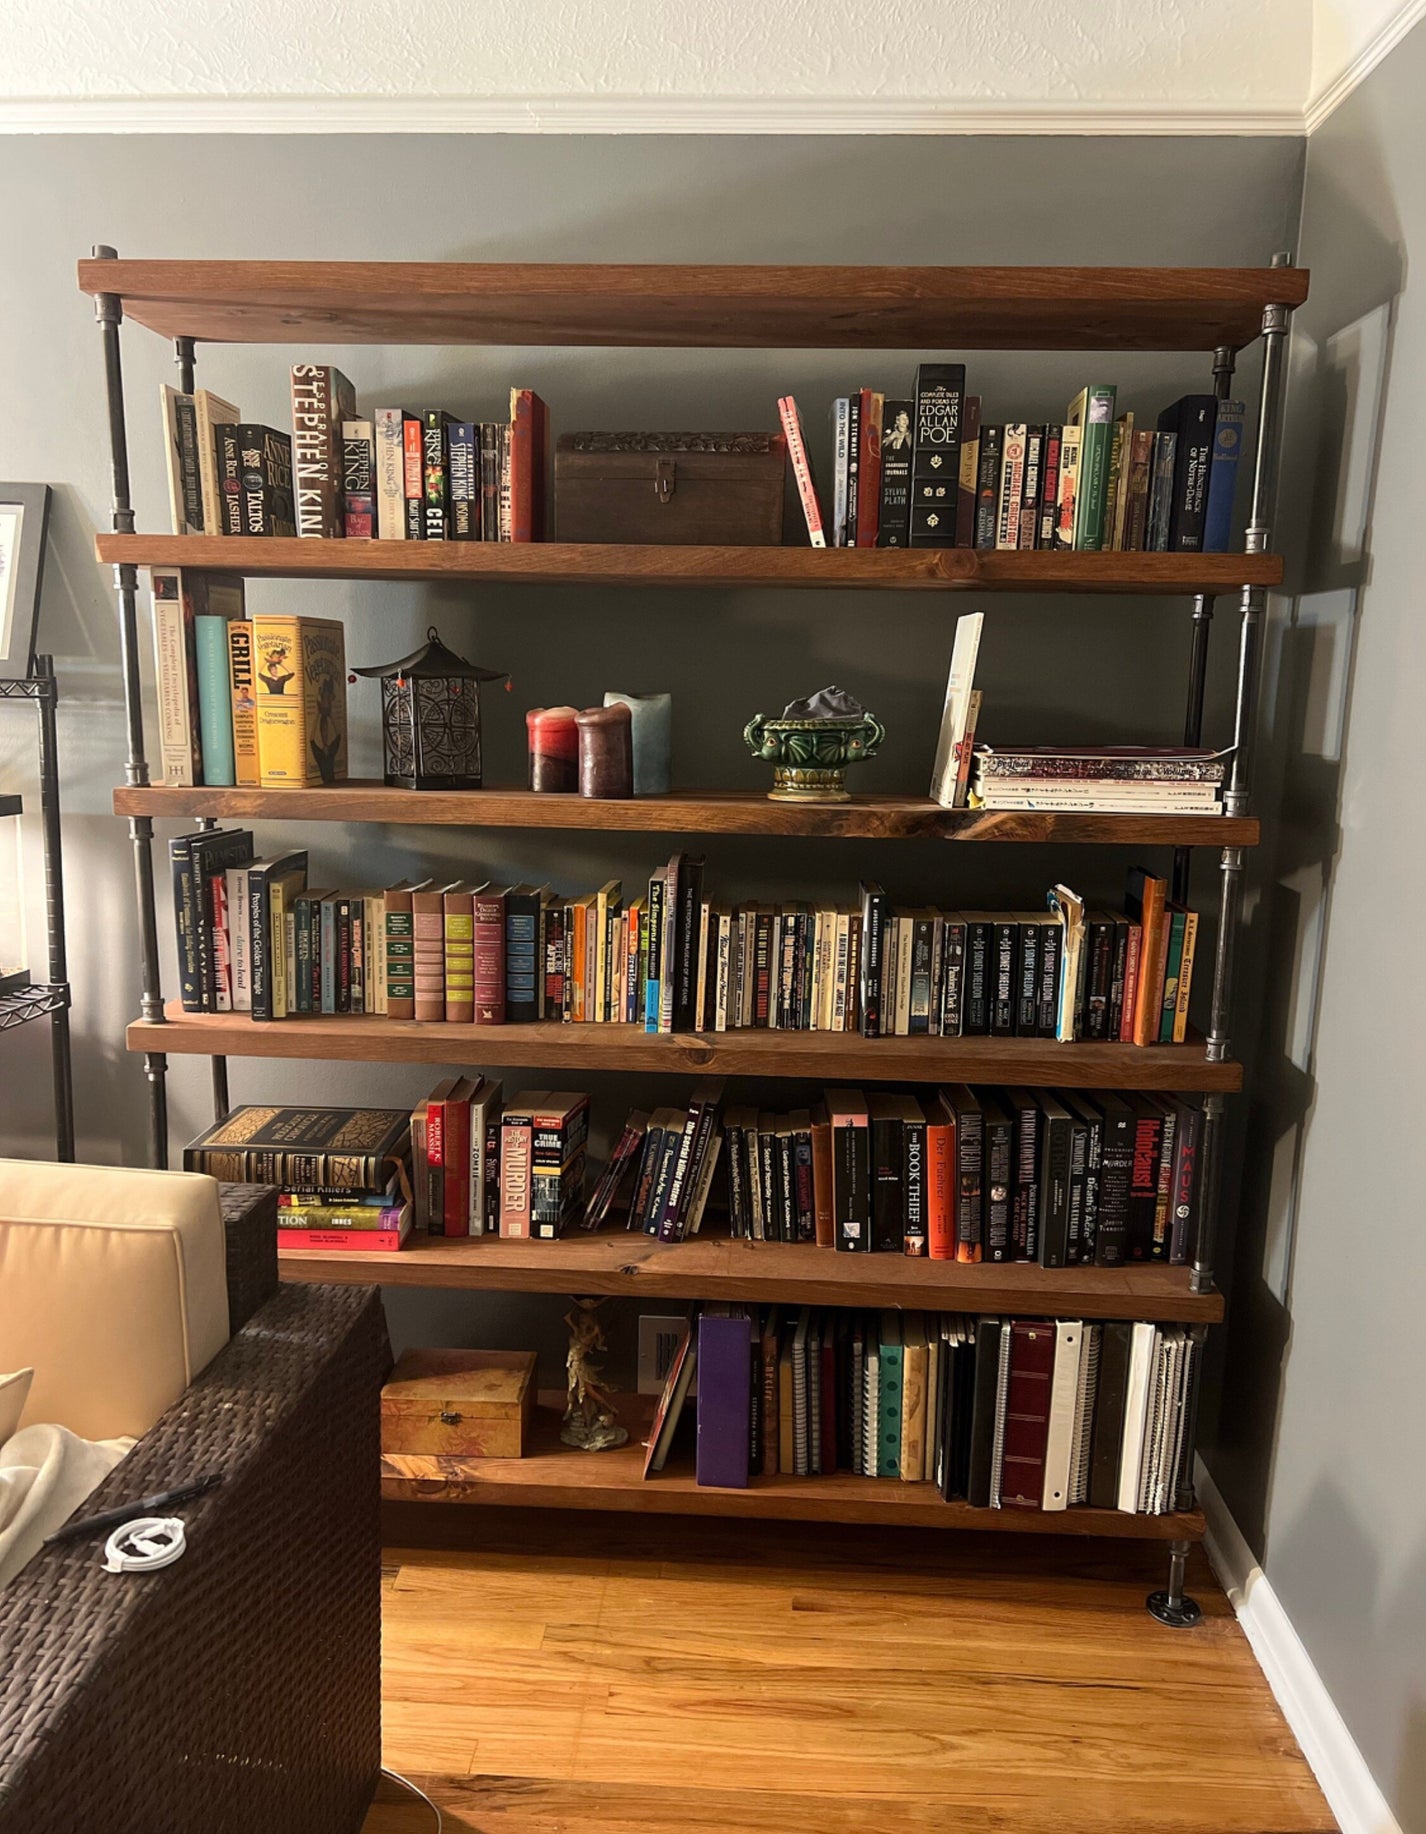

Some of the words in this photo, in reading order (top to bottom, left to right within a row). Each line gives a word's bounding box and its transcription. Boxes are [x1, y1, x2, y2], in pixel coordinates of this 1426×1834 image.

[293, 365, 320, 478] STEPHEN
[919, 416, 958, 427] ALLAN
[920, 405, 958, 416] EDGAR
[316, 371, 329, 481] DESPERATION
[920, 427, 956, 444] POE
[224, 437, 235, 459] ANNE
[425, 429, 436, 464] KING
[1199, 446, 1209, 463] THE
[226, 460, 237, 477] RICE
[344, 441, 360, 490] KING
[360, 441, 369, 490] STEPHEN
[450, 442, 468, 478] STEPHEN
[267, 461, 291, 488] RICE
[386, 463, 395, 485] KING
[1011, 461, 1022, 497] MICHAEL
[451, 480, 468, 500] KING
[884, 488, 907, 496] SYLVIA
[884, 496, 906, 505] PLATH
[1194, 465, 1206, 513] HUNCHBACK
[227, 494, 240, 533] LASHER
[246, 490, 264, 532] TALTOS
[455, 502, 468, 534] INSOMNIA
[1007, 501, 1019, 543] CRICHTON
[977, 507, 987, 544] GRISHAM
[986, 515, 994, 537] JOHN
[231, 632, 252, 689] GRILL
[160, 610, 168, 652] VEGETABLES
[165, 708, 173, 739] COOKING
[251, 893, 261, 918] Peoples
[652, 885, 660, 901] The
[651, 904, 660, 941] Simpsons
[684, 900, 692, 942] METROPOLITAN
[212, 927, 223, 949] START
[236, 936, 245, 957] dare
[214, 951, 225, 970] WITH
[237, 959, 244, 967] to
[254, 940, 262, 965] Golden
[546, 944, 555, 973] AFTER
[555, 940, 563, 972] BEFORE
[974, 951, 984, 970] SIDNEY
[1000, 951, 1010, 972] SIDNEY
[1025, 949, 1035, 968] SIDNEY
[1044, 952, 1054, 972] SIDNEY
[215, 972, 225, 988] WHY
[237, 969, 246, 989] lead
[254, 967, 263, 995] Triangle
[628, 954, 636, 996] president
[948, 966, 960, 993] Pandora's
[973, 972, 983, 998] SHELDON
[998, 972, 1009, 1000] SHELDON
[1023, 970, 1033, 997] SHELDON
[1181, 958, 1191, 988] Treasure
[1042, 974, 1053, 1001] SHELDON
[947, 994, 957, 1009] Clock
[1179, 991, 1188, 1012] Island
[685, 1121, 695, 1135] the
[960, 1115, 981, 1141] DANCE
[1020, 1110, 1036, 1143] PATRICIA
[534, 1140, 562, 1149] CRIME
[681, 1135, 691, 1158] serial
[936, 1137, 946, 1155] Der
[1132, 1120, 1160, 1187] Holocaust
[674, 1159, 686, 1180] killer
[909, 1144, 920, 1181] BOOK
[960, 1145, 981, 1172] DEATH
[1019, 1144, 1035, 1183] CORNWELL
[505, 1148, 528, 1212] MURDER
[936, 1162, 946, 1199] Fuehrer
[1180, 1145, 1195, 1203] MAUS
[668, 1180, 682, 1206] letters
[908, 1183, 920, 1222] THIEF
[1028, 1184, 1037, 1216] PORTRAIT
[1071, 1185, 1080, 1208] THOMAS
[1085, 1177, 1096, 1212] Death's
[278, 1216, 307, 1225] TION
[990, 1205, 1007, 1224] BOOK
[1083, 1215, 1092, 1238] Acre
[990, 1228, 1006, 1246] DEAD
[1027, 1233, 1036, 1255] KILLER
